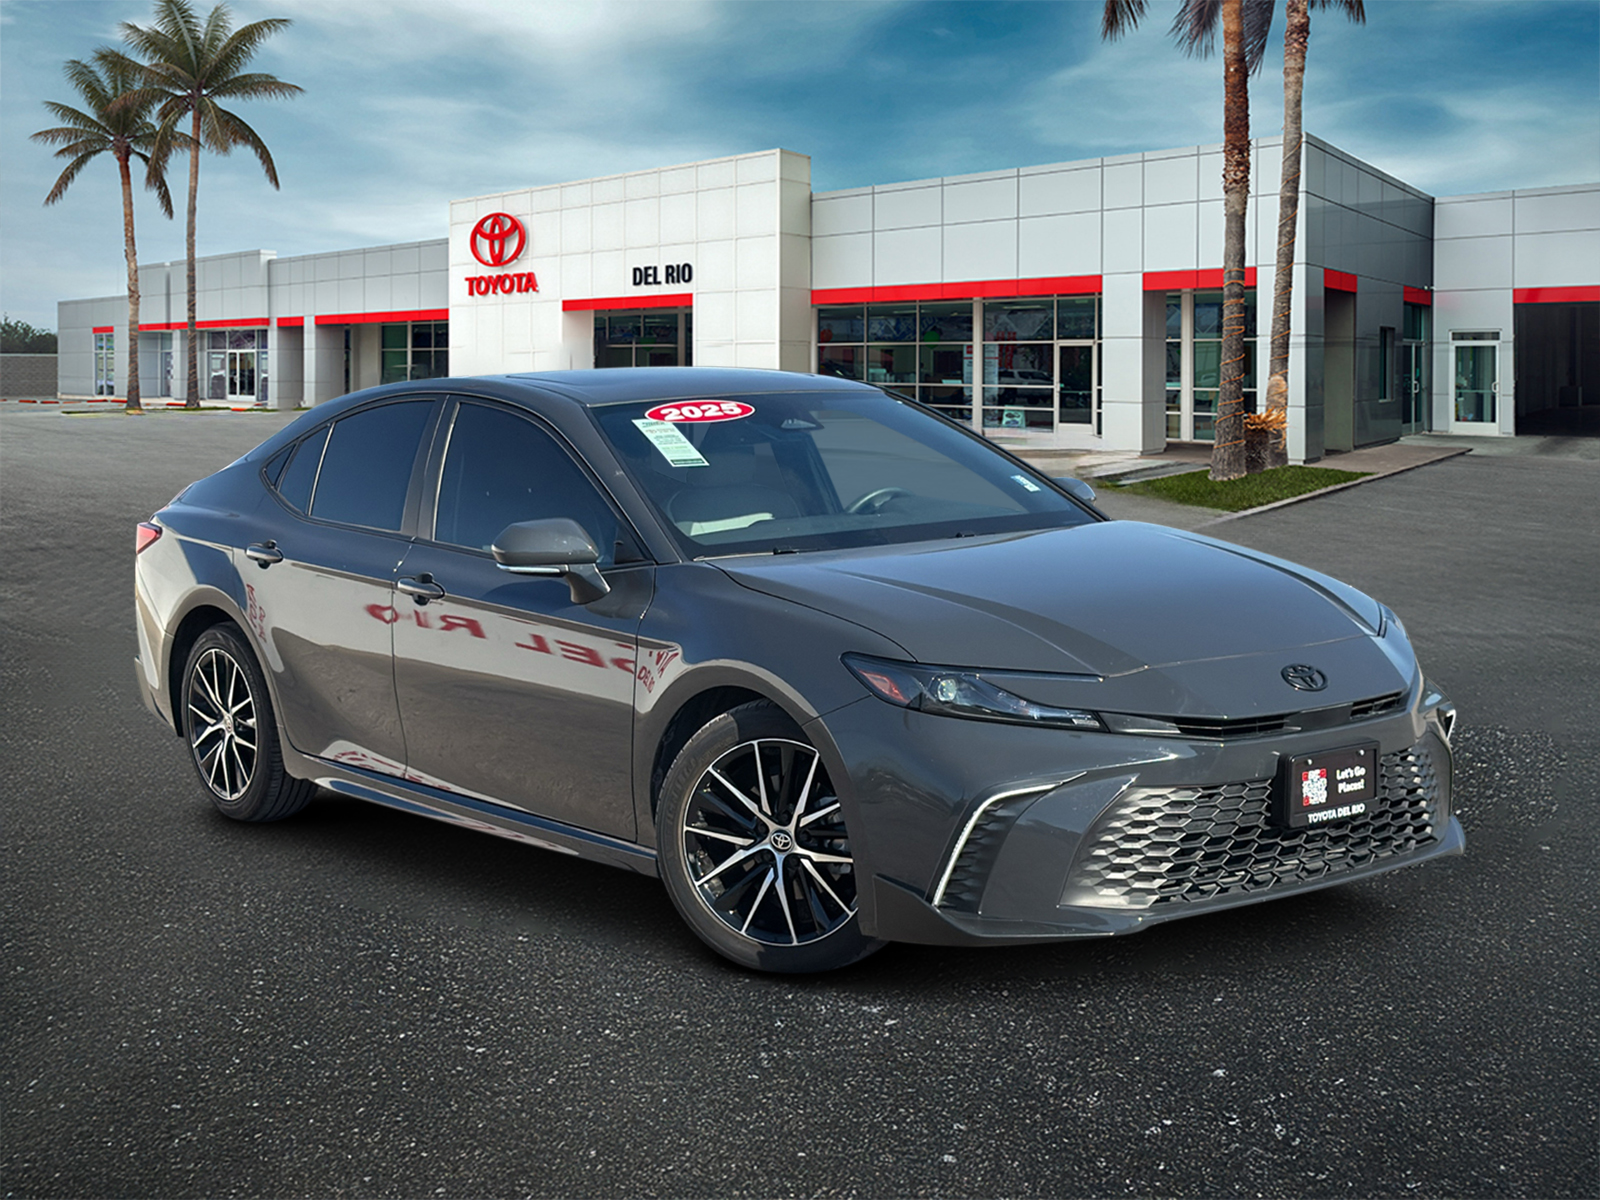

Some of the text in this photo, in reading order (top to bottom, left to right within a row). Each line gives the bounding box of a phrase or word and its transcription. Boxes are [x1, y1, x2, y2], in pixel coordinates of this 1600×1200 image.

[465, 271, 538, 296] TOYOTA
[632, 263, 693, 286] DEL RIO
[660, 402, 742, 420] 2025
[1354, 765, 1366, 777] Go
[1308, 803, 1366, 823] TOYOTA DEL RIO
